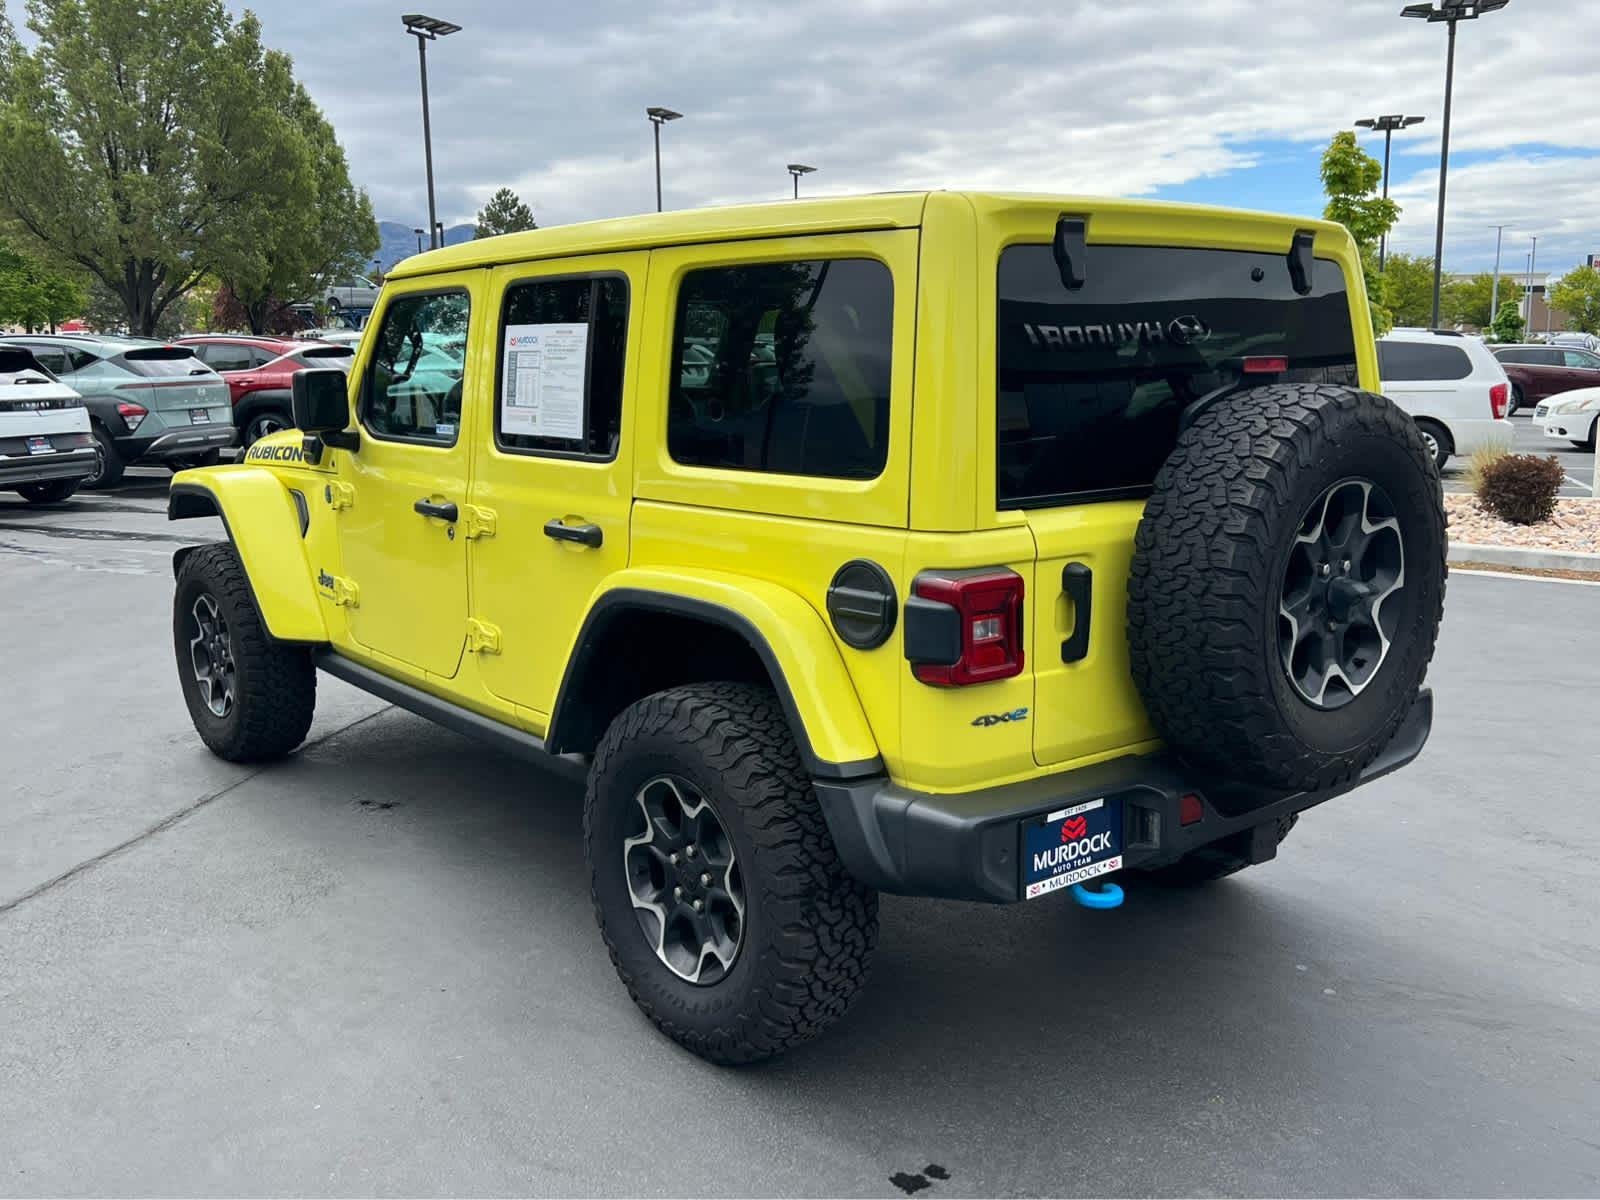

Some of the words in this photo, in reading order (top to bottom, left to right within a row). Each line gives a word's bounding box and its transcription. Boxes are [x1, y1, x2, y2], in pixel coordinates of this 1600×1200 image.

[248, 446, 304, 462] RUBICON
[1033, 831, 1111, 872] MURDOCK
[1053, 862, 1072, 874] AUTO
[1073, 856, 1092, 867] TEAM
[1049, 865, 1102, 889] MURDOCK
